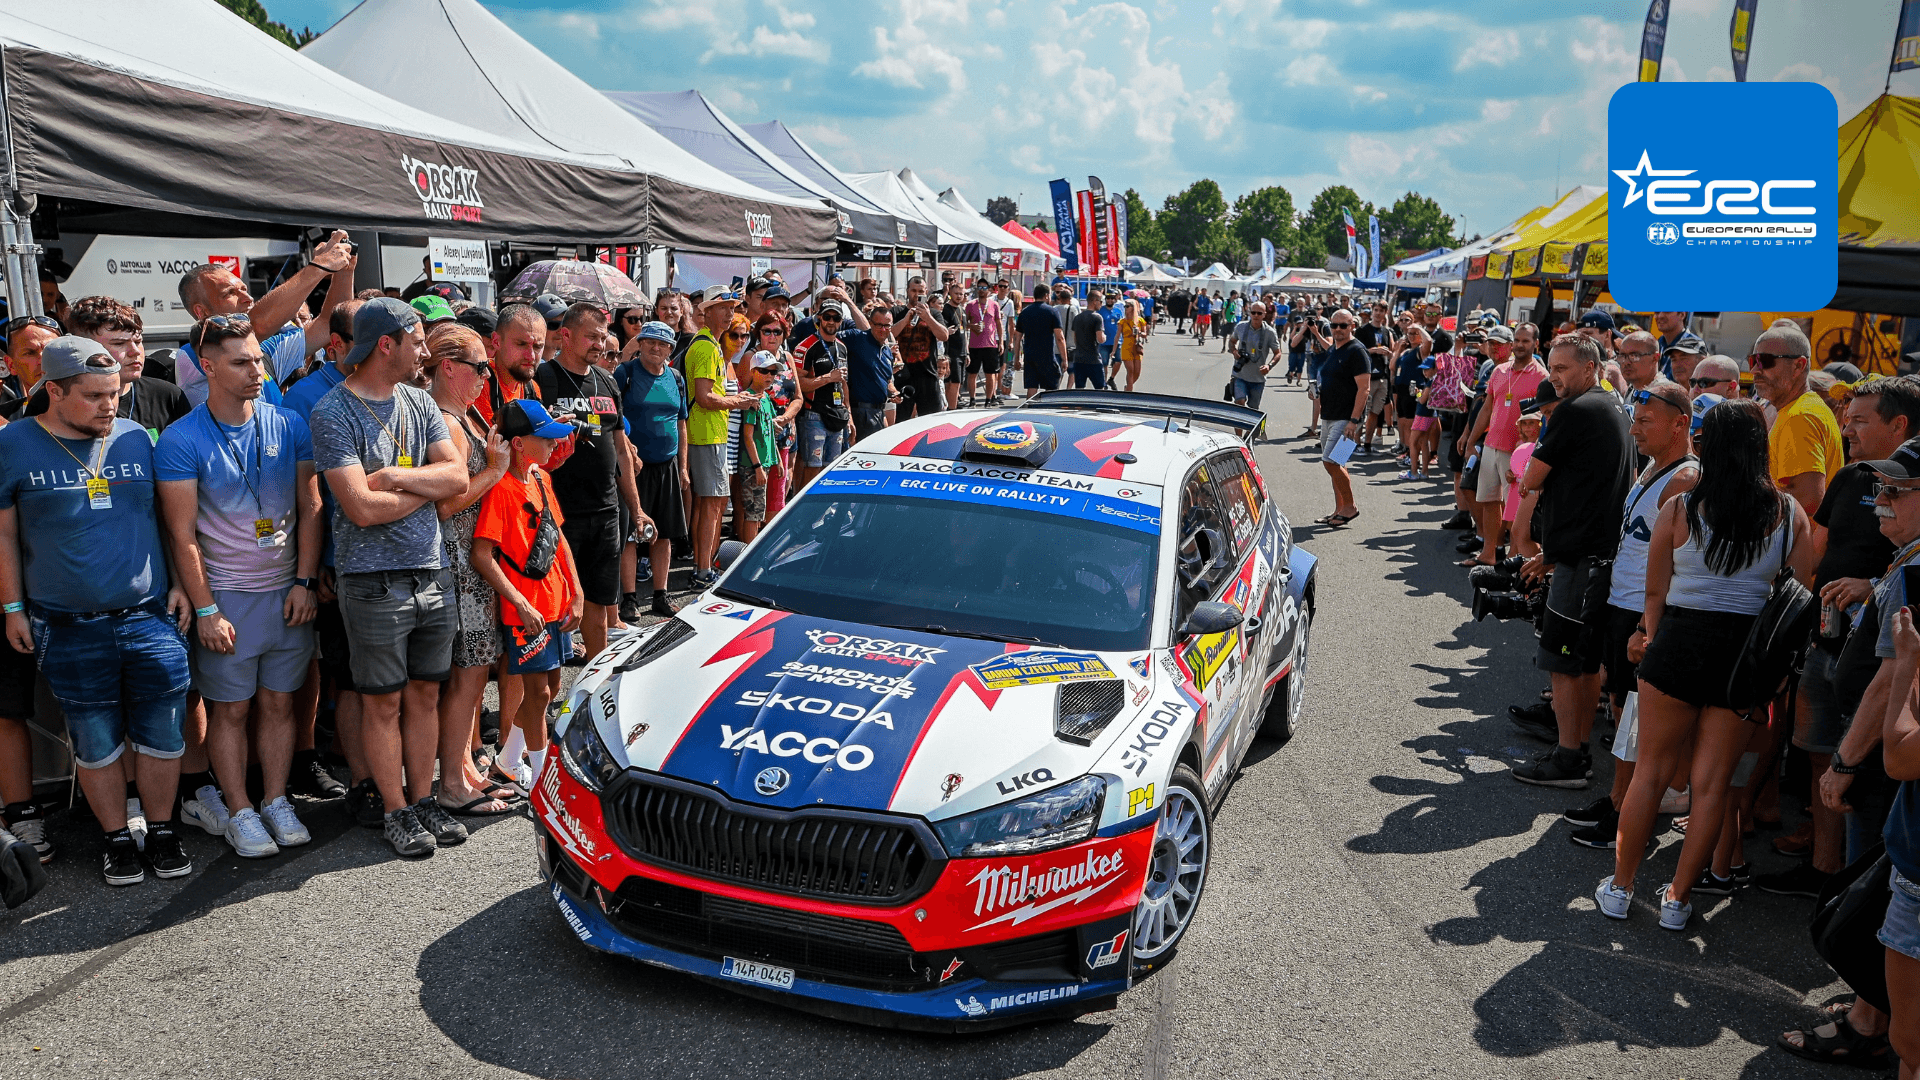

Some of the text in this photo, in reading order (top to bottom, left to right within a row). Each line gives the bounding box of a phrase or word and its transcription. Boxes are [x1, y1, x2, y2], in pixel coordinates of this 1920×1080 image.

[406, 156, 484, 208] ORSAK
[120, 260, 152, 269] AUTOKLUB
[595, 398, 615, 412] OFF
[29, 463, 145, 486] HILFIGER
[898, 461, 1094, 492] YACCO ACCR TEAM
[900, 478, 1071, 507] ERC LIVE ON RALLY.TV
[518, 633, 552, 665] ARMOUR
[521, 629, 549, 654] UNDER
[812, 631, 948, 664] ORSAK
[781, 661, 917, 692] SAMOHYL
[981, 667, 1023, 680] BARUM
[1020, 663, 1055, 675] CZECH
[1052, 661, 1081, 674] RALLY
[807, 674, 913, 699] MOTOR
[600, 688, 617, 720] LKQ
[719, 725, 875, 772] YACCO
[995, 767, 1057, 796] LKQ
[542, 756, 596, 857] Milwaukee
[1127, 782, 1155, 818] P1
[966, 848, 1124, 918] Milwaukee
[558, 898, 593, 942] MICHELIN
[990, 985, 1079, 1010] MICHELIN
